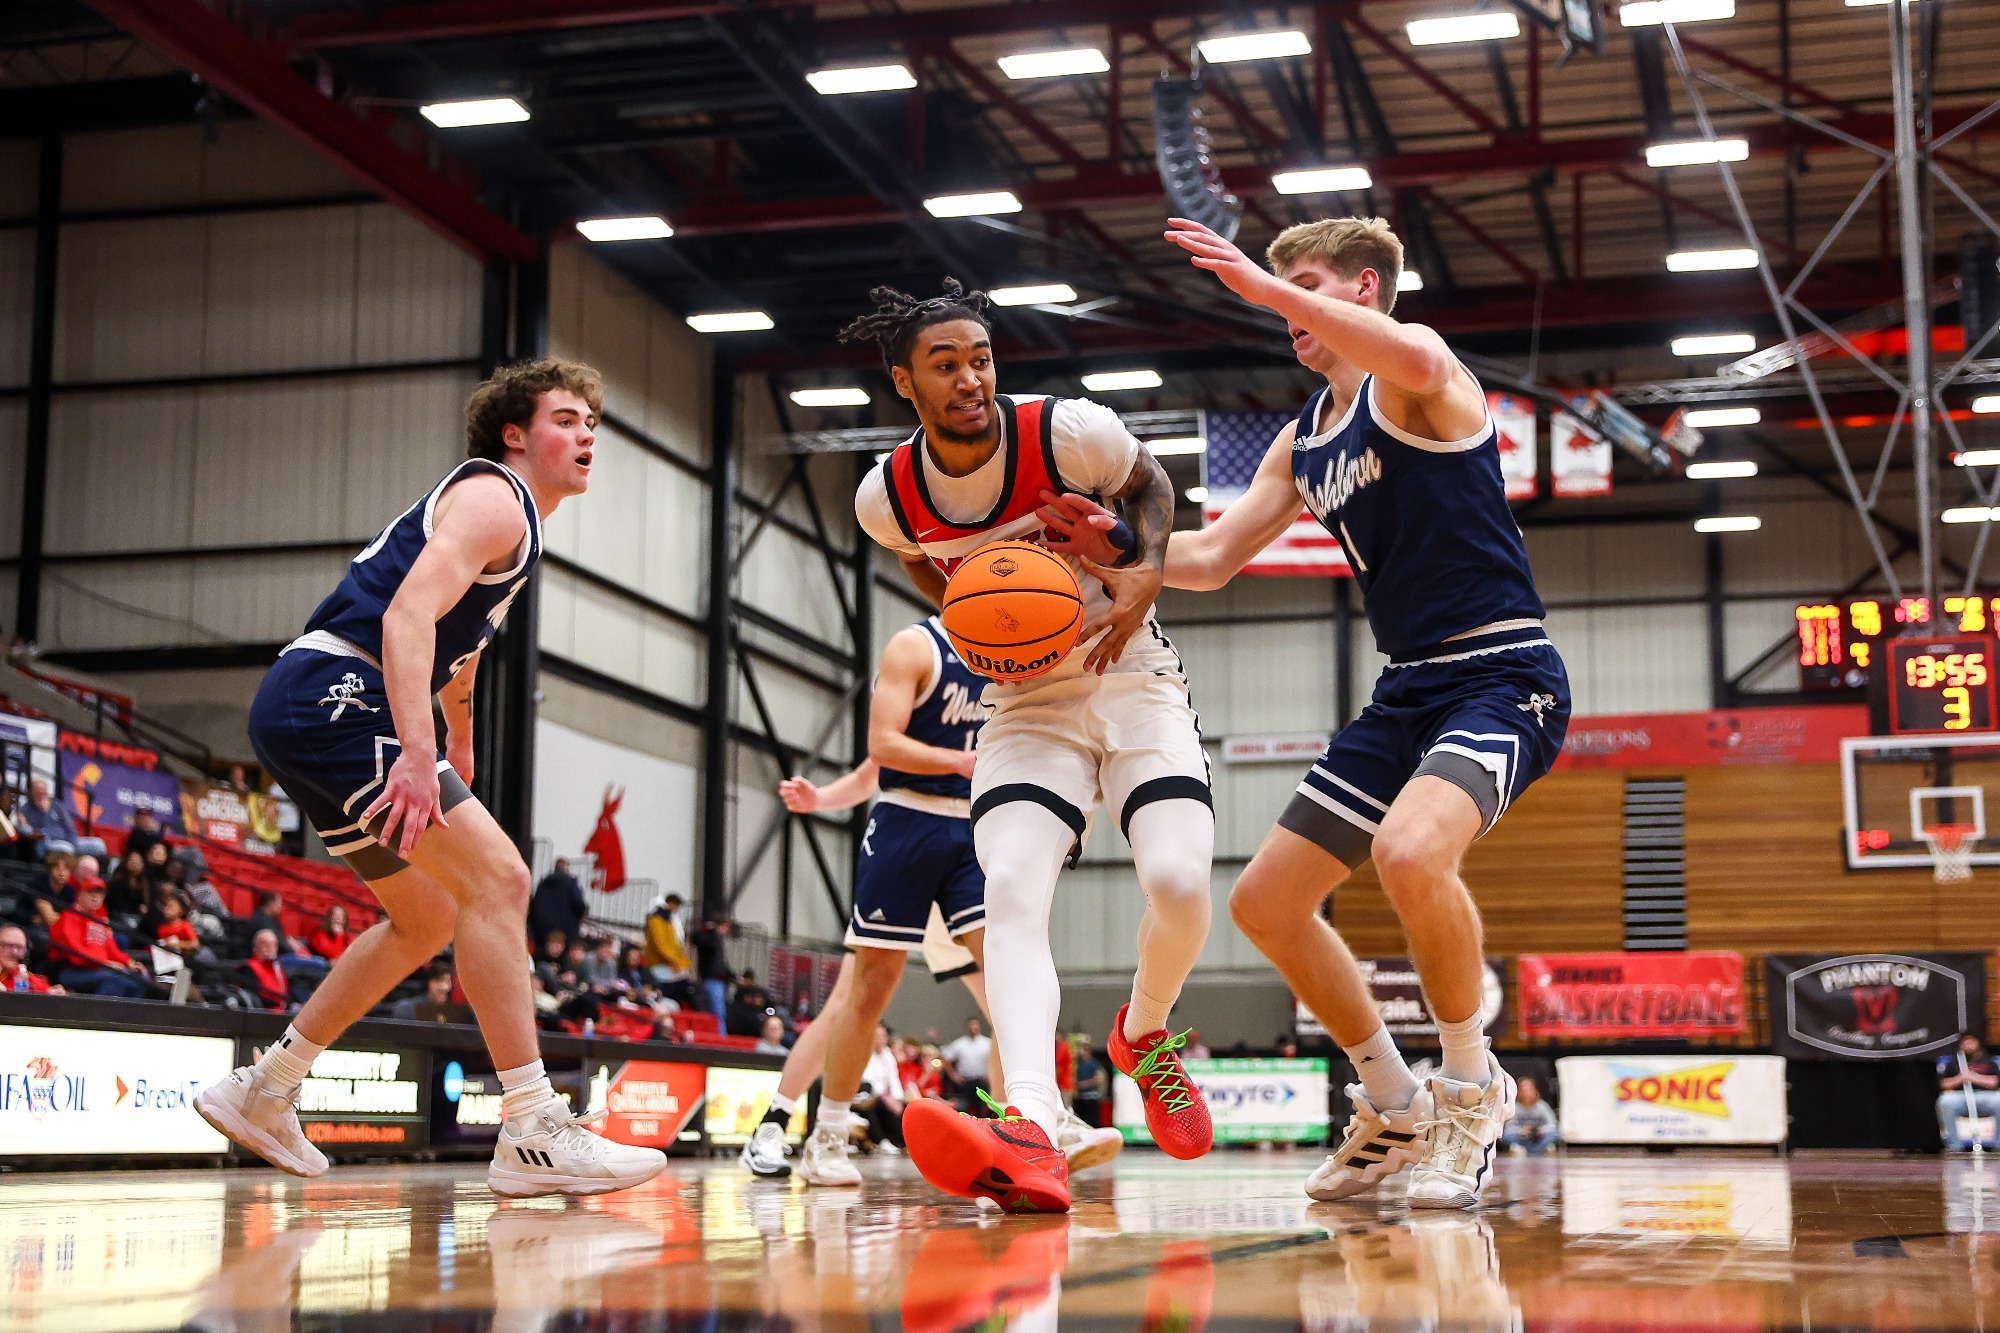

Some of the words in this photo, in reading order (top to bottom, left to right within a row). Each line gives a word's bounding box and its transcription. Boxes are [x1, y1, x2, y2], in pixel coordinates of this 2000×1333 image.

[1339, 520, 1368, 572] 1
[965, 650, 1059, 674] Wilson
[1906, 653, 1987, 688] 13:55
[1942, 687, 1971, 730] 3
[1819, 962, 1930, 994] PHANTOM
[1525, 984, 1740, 1026] BASKETBALL
[0, 1073, 33, 1113] FA
[51, 1074, 90, 1112] OIL
[1618, 1076, 1724, 1102] SONIC
